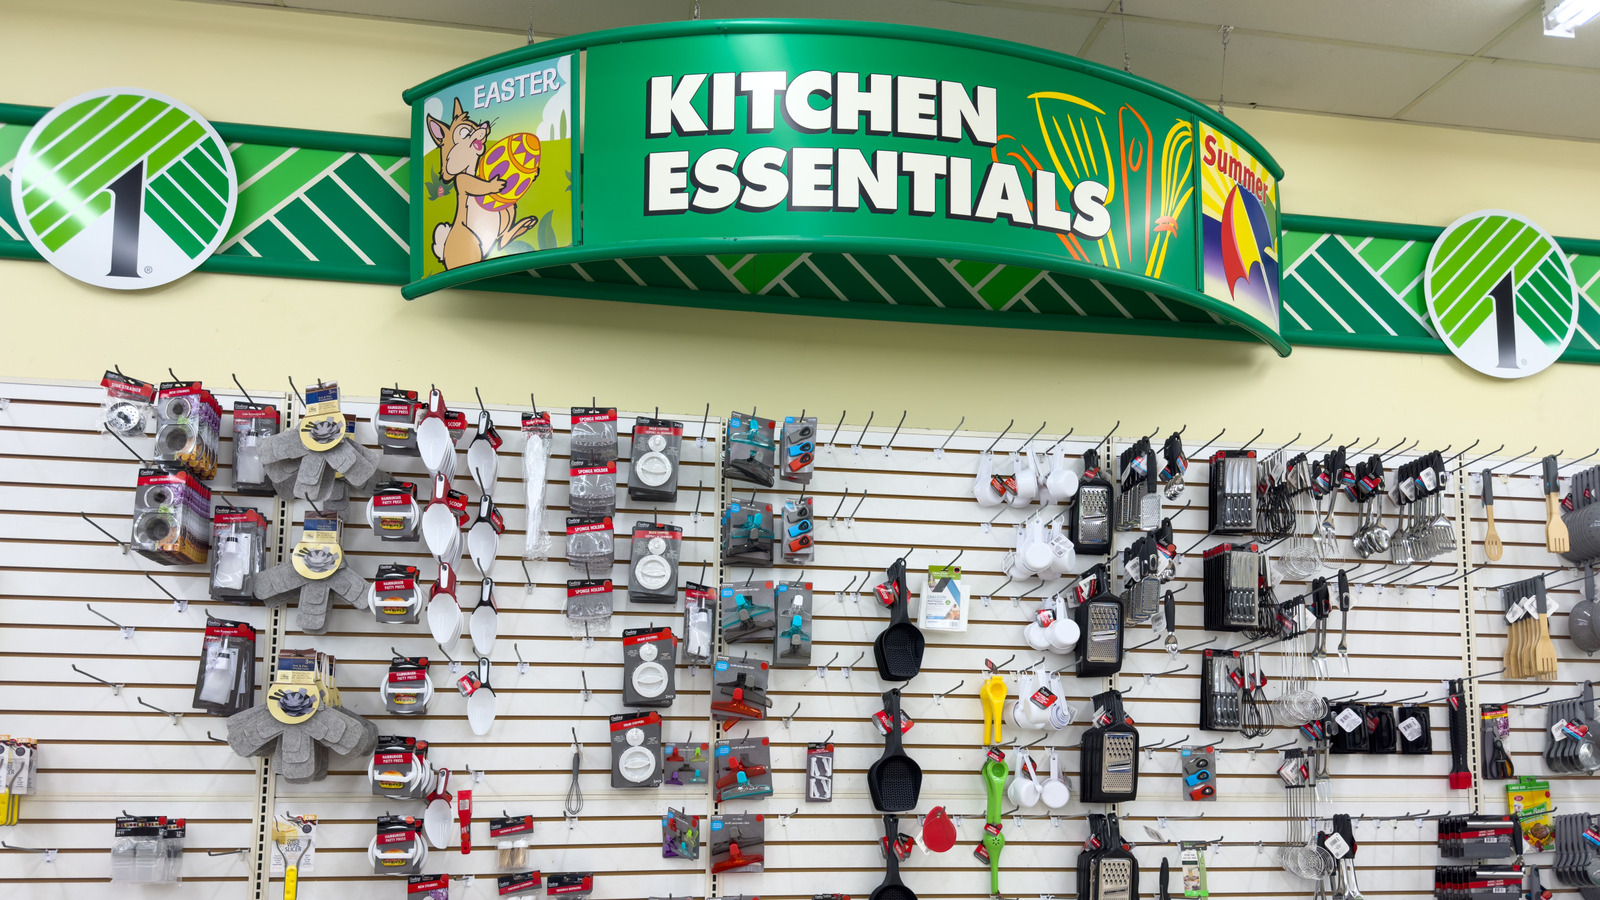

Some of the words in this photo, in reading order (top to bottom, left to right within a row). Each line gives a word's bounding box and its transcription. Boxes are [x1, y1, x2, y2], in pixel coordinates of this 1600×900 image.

[474, 67, 560, 109] EASTER
[646, 70, 997, 147] KITCHEN
[644, 147, 1111, 240] ESSENTIALS
[1203, 134, 1268, 205] Summer
